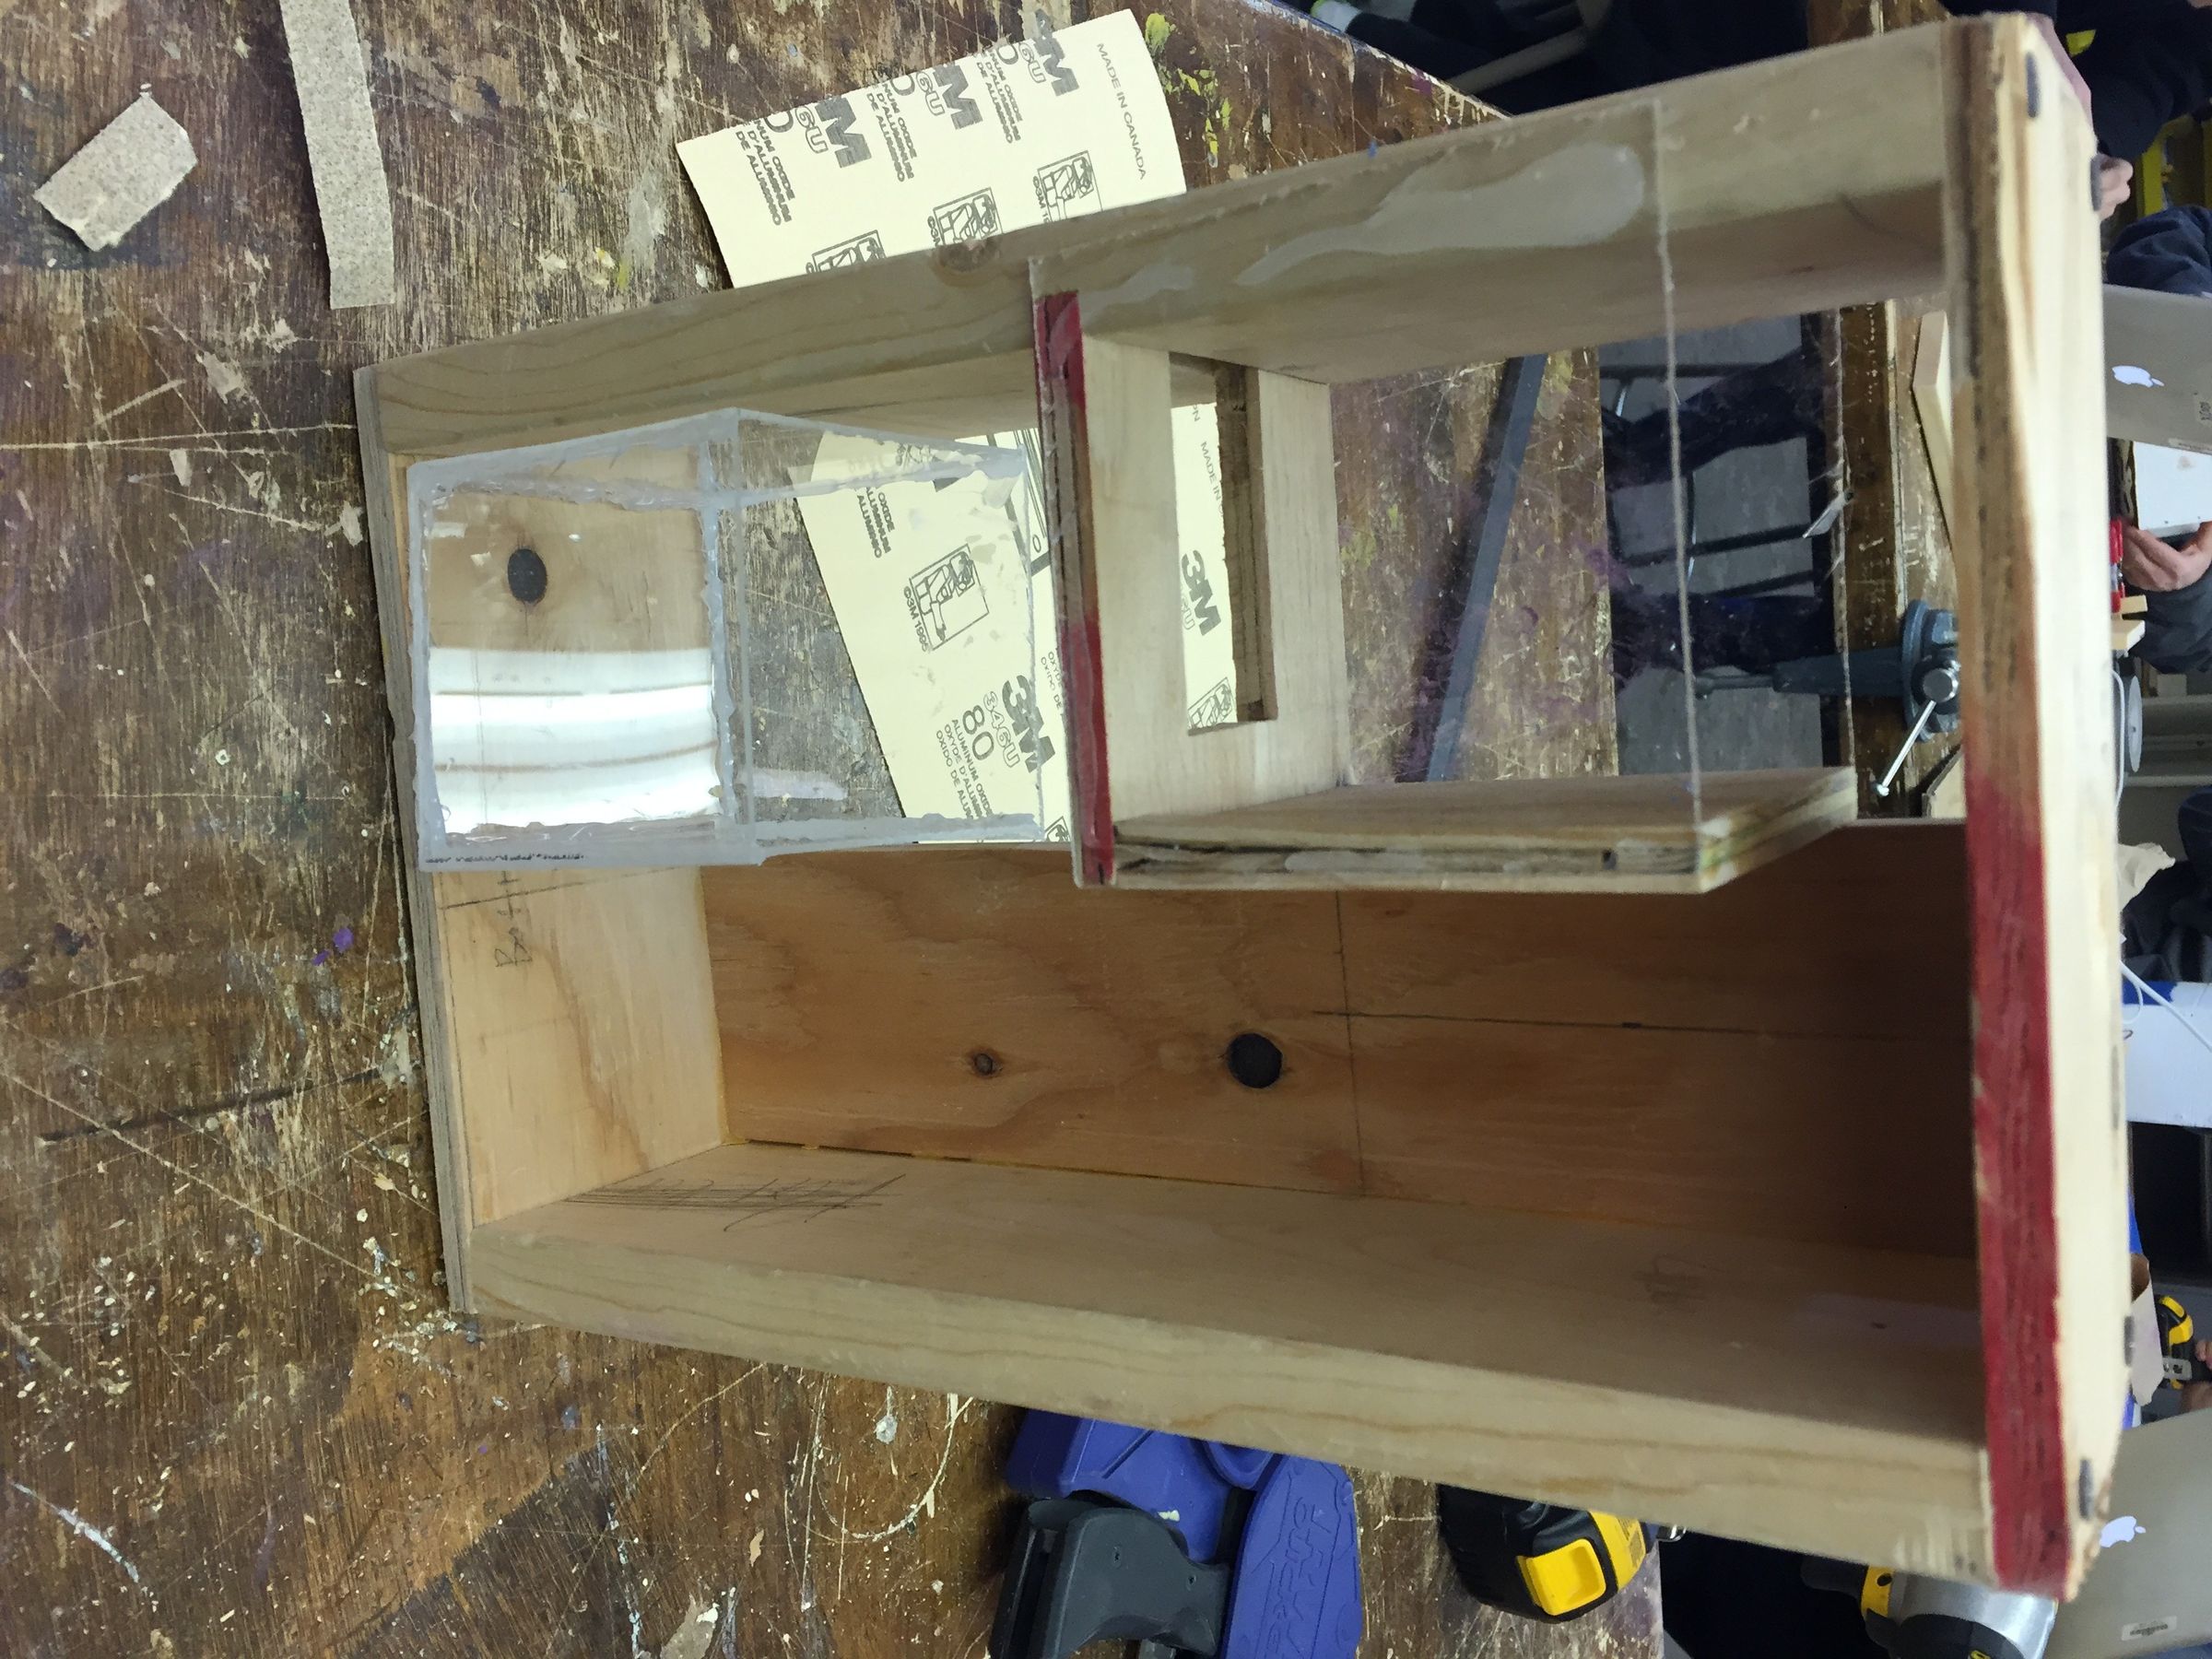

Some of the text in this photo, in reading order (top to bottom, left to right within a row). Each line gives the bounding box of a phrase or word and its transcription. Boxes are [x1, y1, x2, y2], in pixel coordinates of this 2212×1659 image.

[915, 71, 946, 116] 6U
[933, 63, 983, 130] M
[1004, 84, 1023, 122] OXIDE
[1097, 43, 1147, 181] MADE IN CANADA
[794, 106, 829, 154] 6U
[815, 95, 872, 169] M
[866, 93, 905, 182] DE ALUMINIO
[898, 116, 917, 159] OXIDE
[735, 131, 782, 226] DE ALUMINIO
[772, 156, 795, 201] OXIDE
[1201, 441, 1218, 484] MADE
[857, 494, 882, 559] ALUMINIO
[877, 491, 895, 532] OXIDE
[1182, 549, 1222, 636] 3M
[944, 724, 961, 764] OXYDE
[951, 718, 979, 782] ALUMINUM
[962, 704, 994, 761] 80
[983, 690, 1020, 769] 346U
[1002, 674, 1056, 773] 3M
[935, 730, 953, 768] OXIDO
[950, 770, 961, 787] DE
